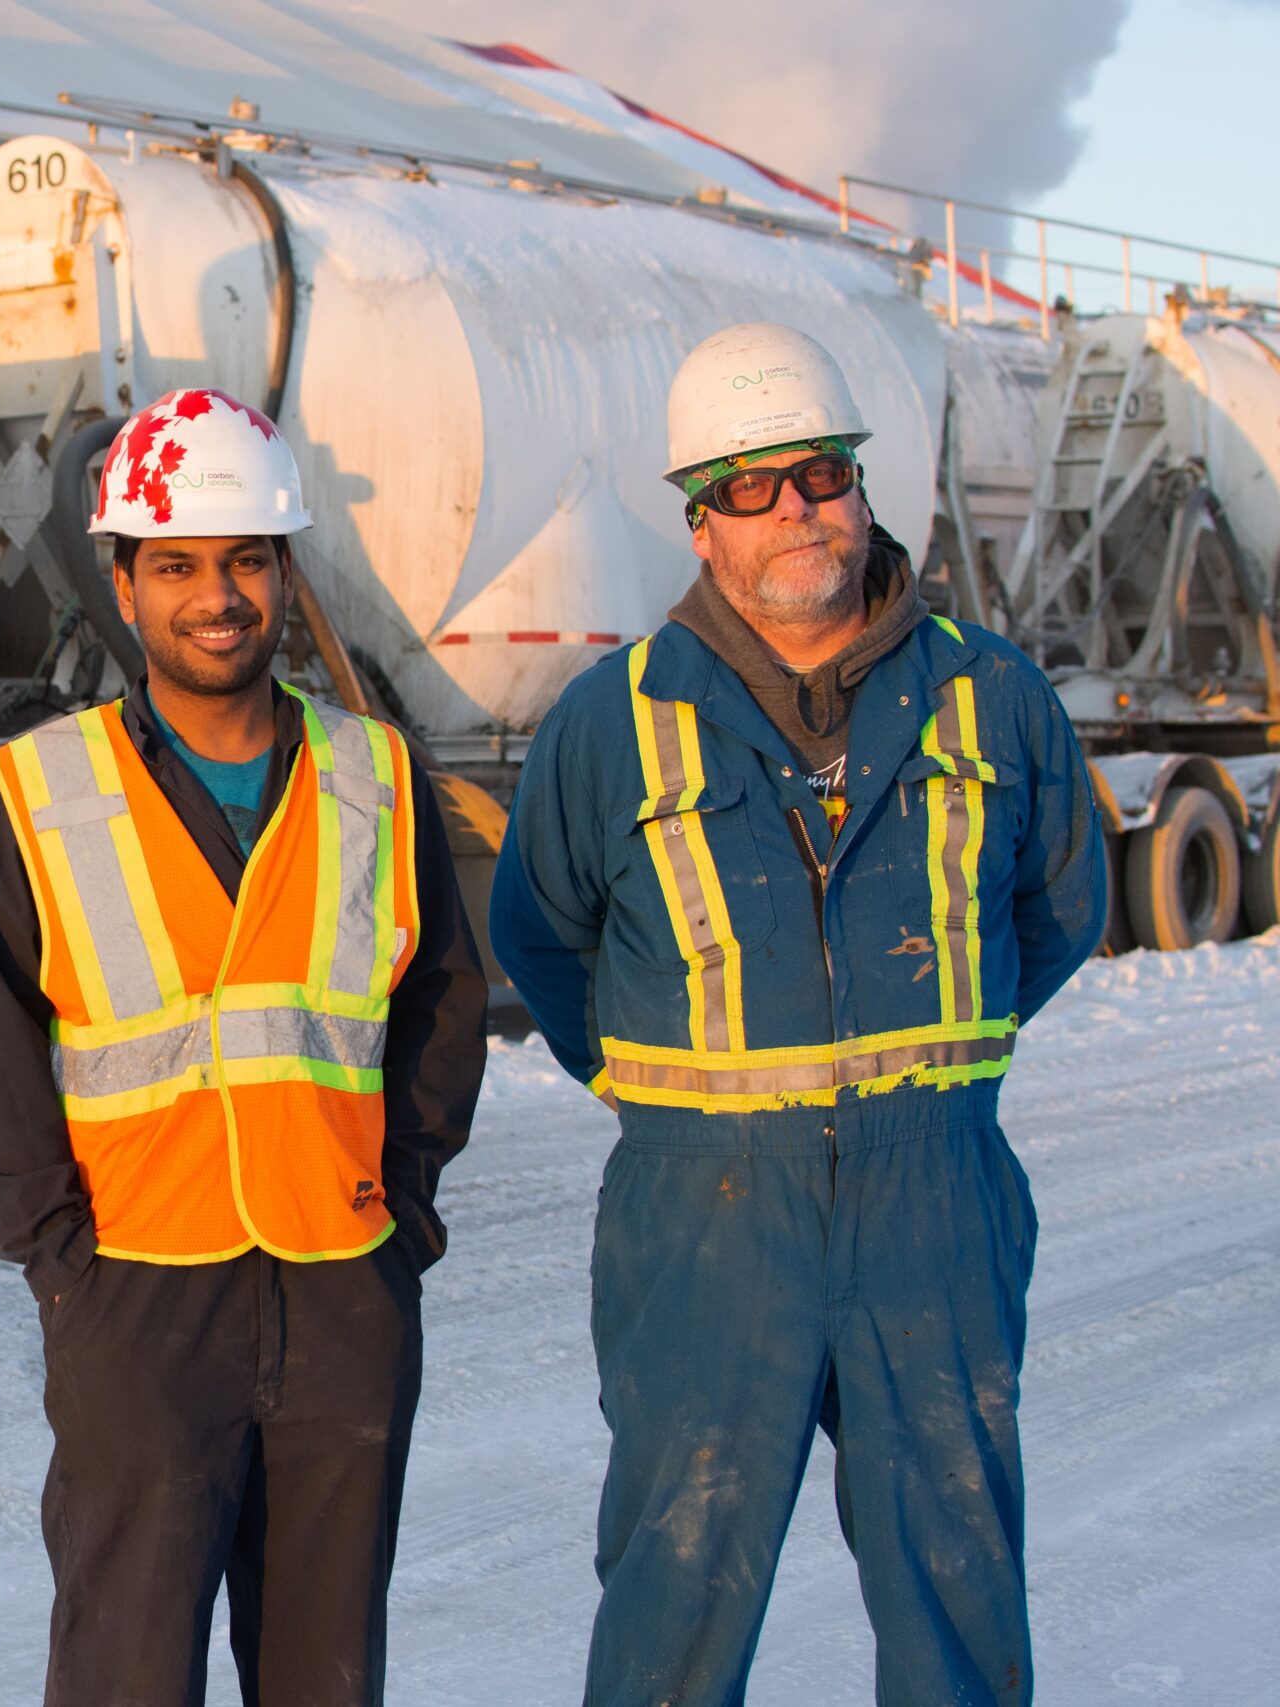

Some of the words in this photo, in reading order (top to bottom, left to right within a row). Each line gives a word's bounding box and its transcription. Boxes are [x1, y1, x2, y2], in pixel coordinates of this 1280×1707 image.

[8, 152, 66, 193] 610
[773, 411, 802, 421] MANAGER
[762, 422, 795, 433] BELANGER
[207, 480, 243, 488] upcycling
